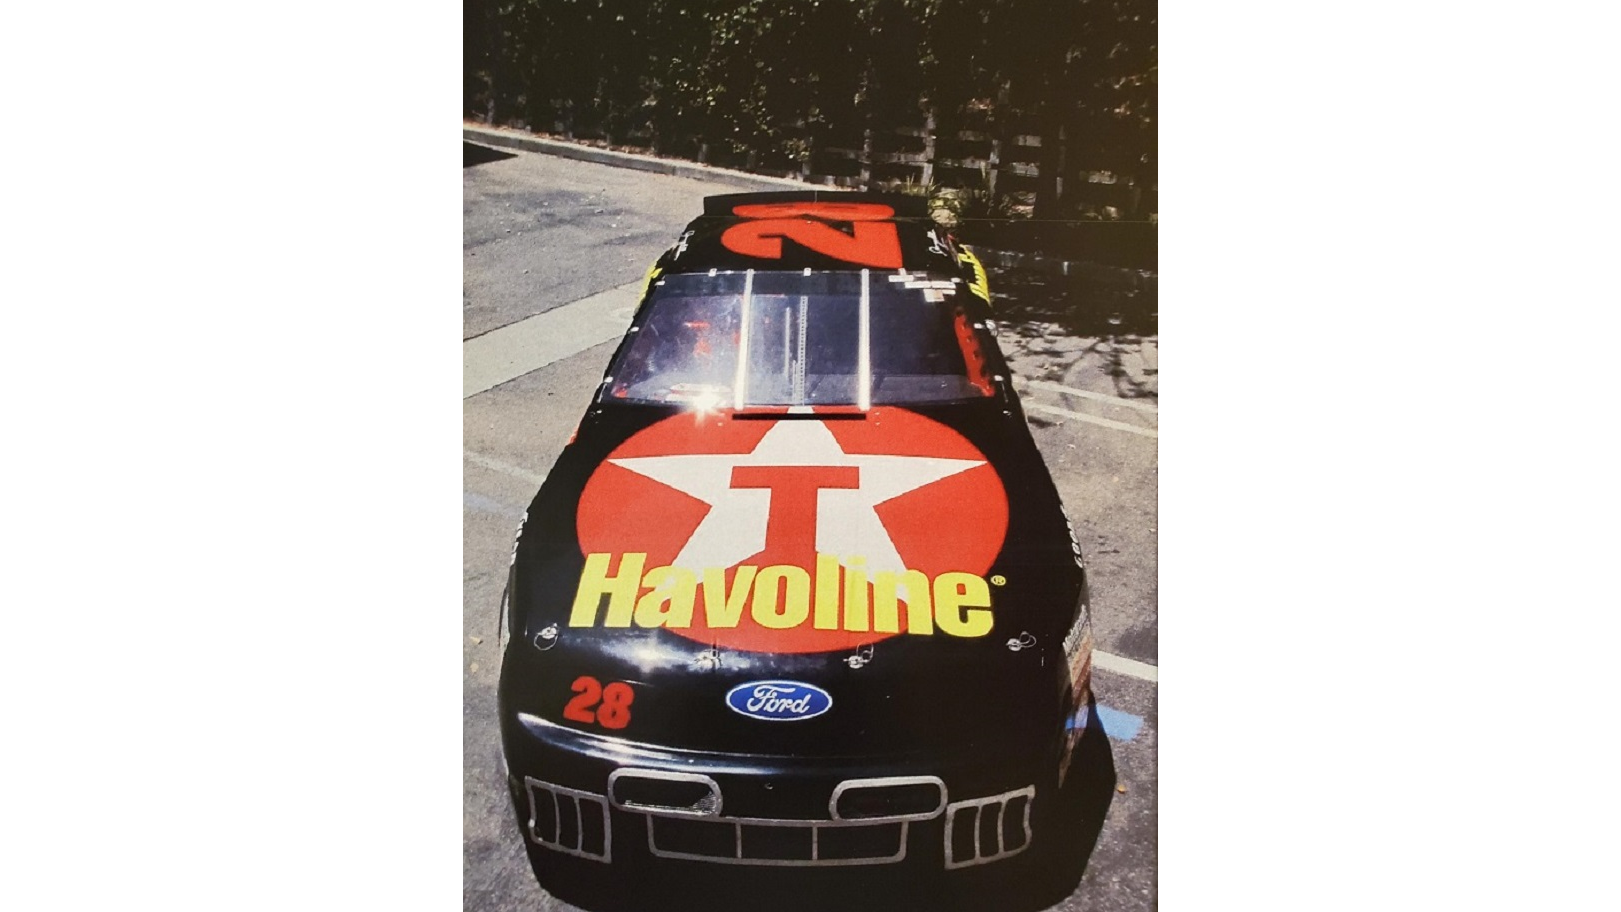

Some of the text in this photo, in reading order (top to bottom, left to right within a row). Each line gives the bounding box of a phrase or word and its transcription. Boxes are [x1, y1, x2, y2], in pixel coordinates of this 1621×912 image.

[721, 202, 903, 268] 28
[729, 465, 861, 557] T
[563, 676, 634, 729] 28
[746, 684, 811, 714] Ford
